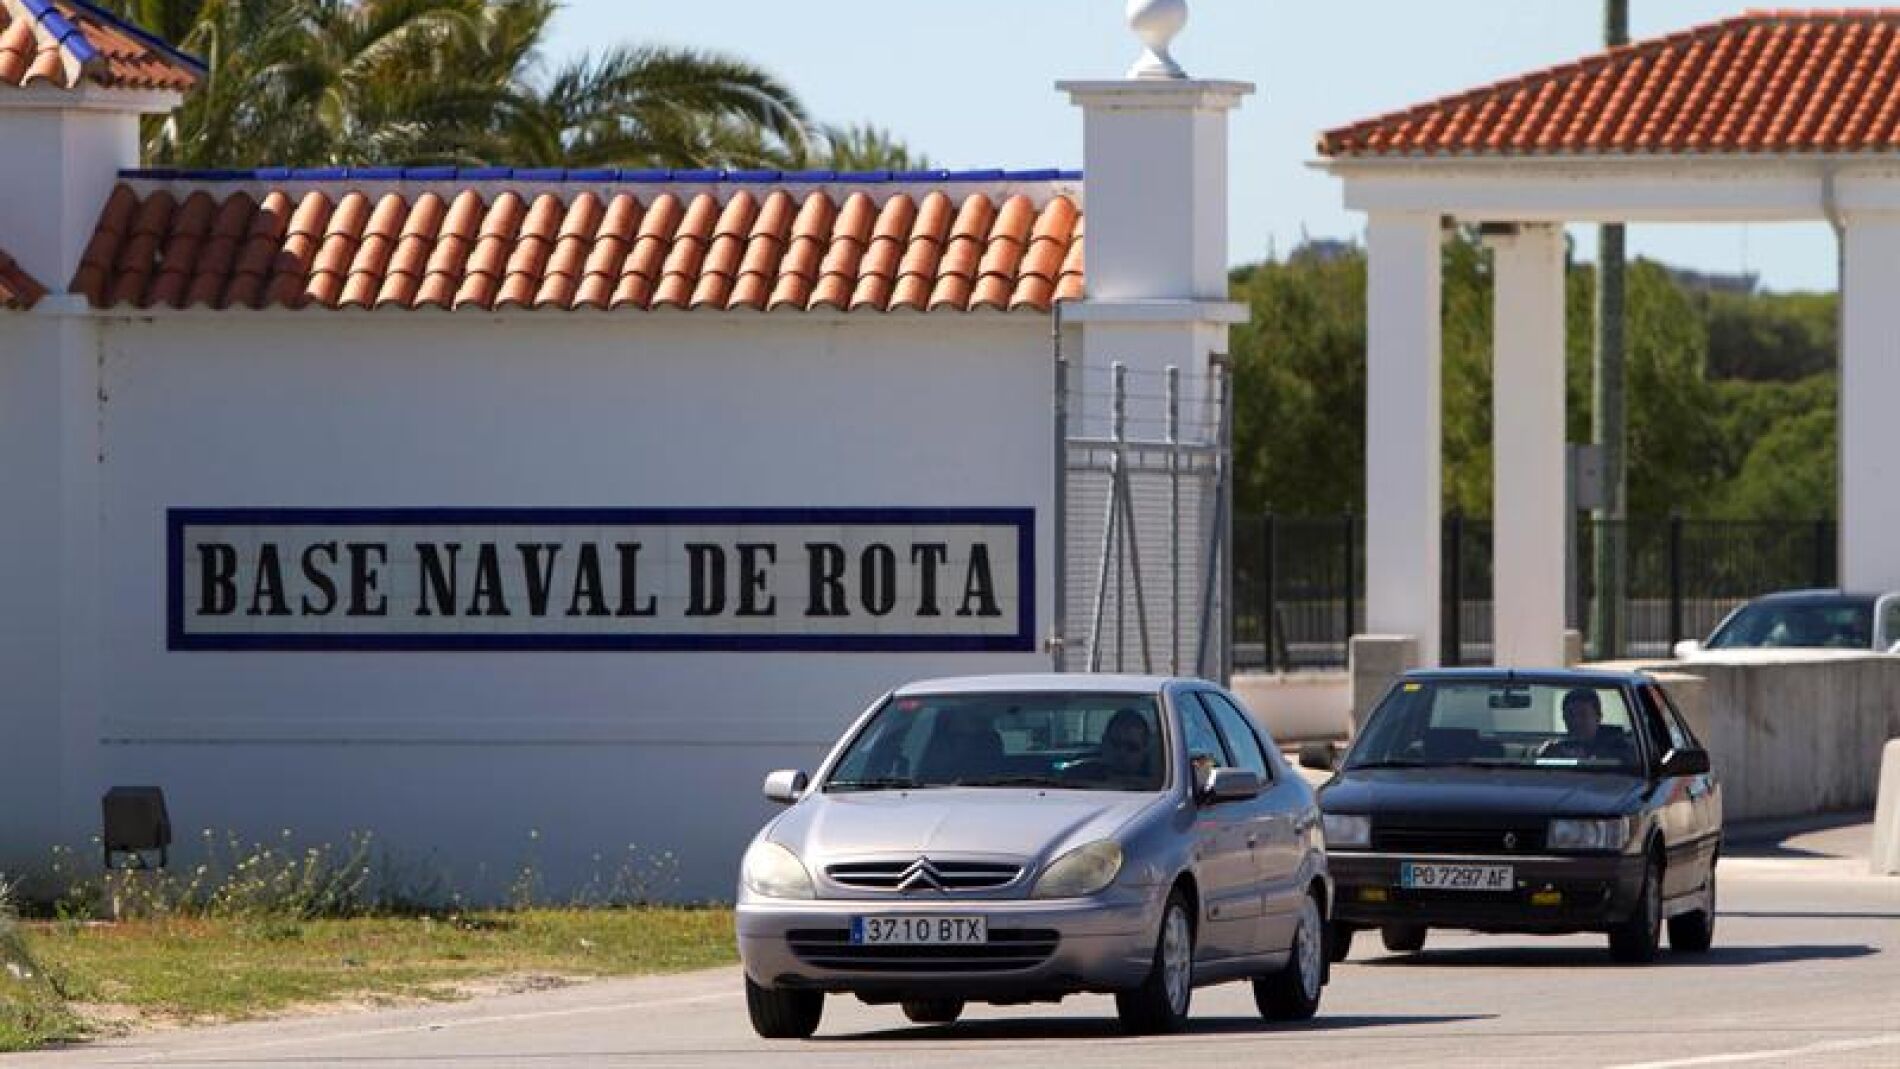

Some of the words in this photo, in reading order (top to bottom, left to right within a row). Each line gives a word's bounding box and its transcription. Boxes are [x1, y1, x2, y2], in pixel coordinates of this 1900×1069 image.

[195, 541, 388, 617] BASE
[414, 541, 658, 617] NAVAL
[684, 541, 777, 617] DE
[804, 541, 1003, 617] ROTA
[868, 918, 930, 941] 3710
[938, 918, 980, 941] BTX
